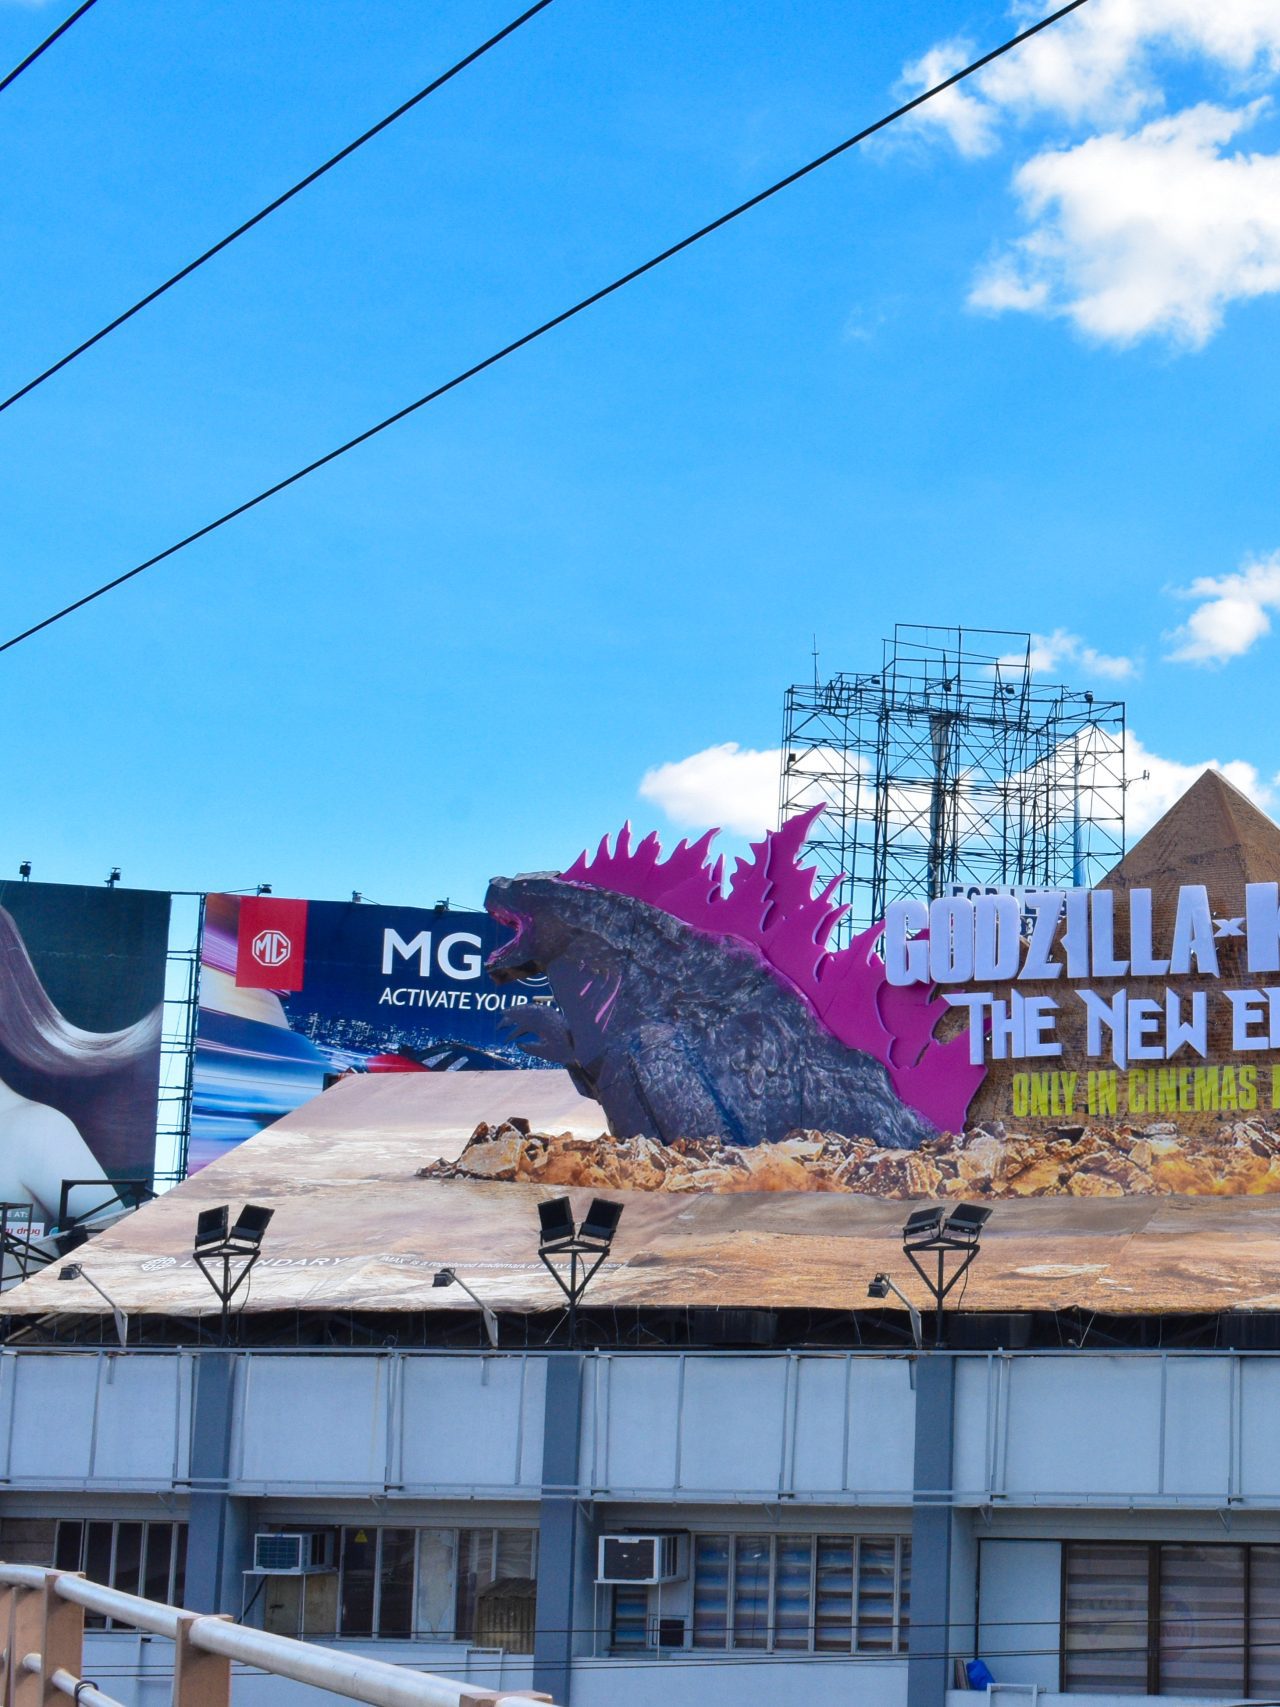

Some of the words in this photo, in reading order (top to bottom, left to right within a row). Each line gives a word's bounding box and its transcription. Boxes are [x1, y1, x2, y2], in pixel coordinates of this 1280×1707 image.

[255, 933, 288, 964] MG
[382, 927, 482, 981] MG
[885, 884, 1220, 986] GODZILLA
[379, 986, 472, 1011] ACTIVATE
[942, 988, 1062, 1066] THE
[1075, 987, 1208, 1070] NEW
[1012, 1070, 1078, 1117] ONLY
[1086, 1070, 1117, 1115] IN
[1127, 1065, 1257, 1114] CINEMAS
